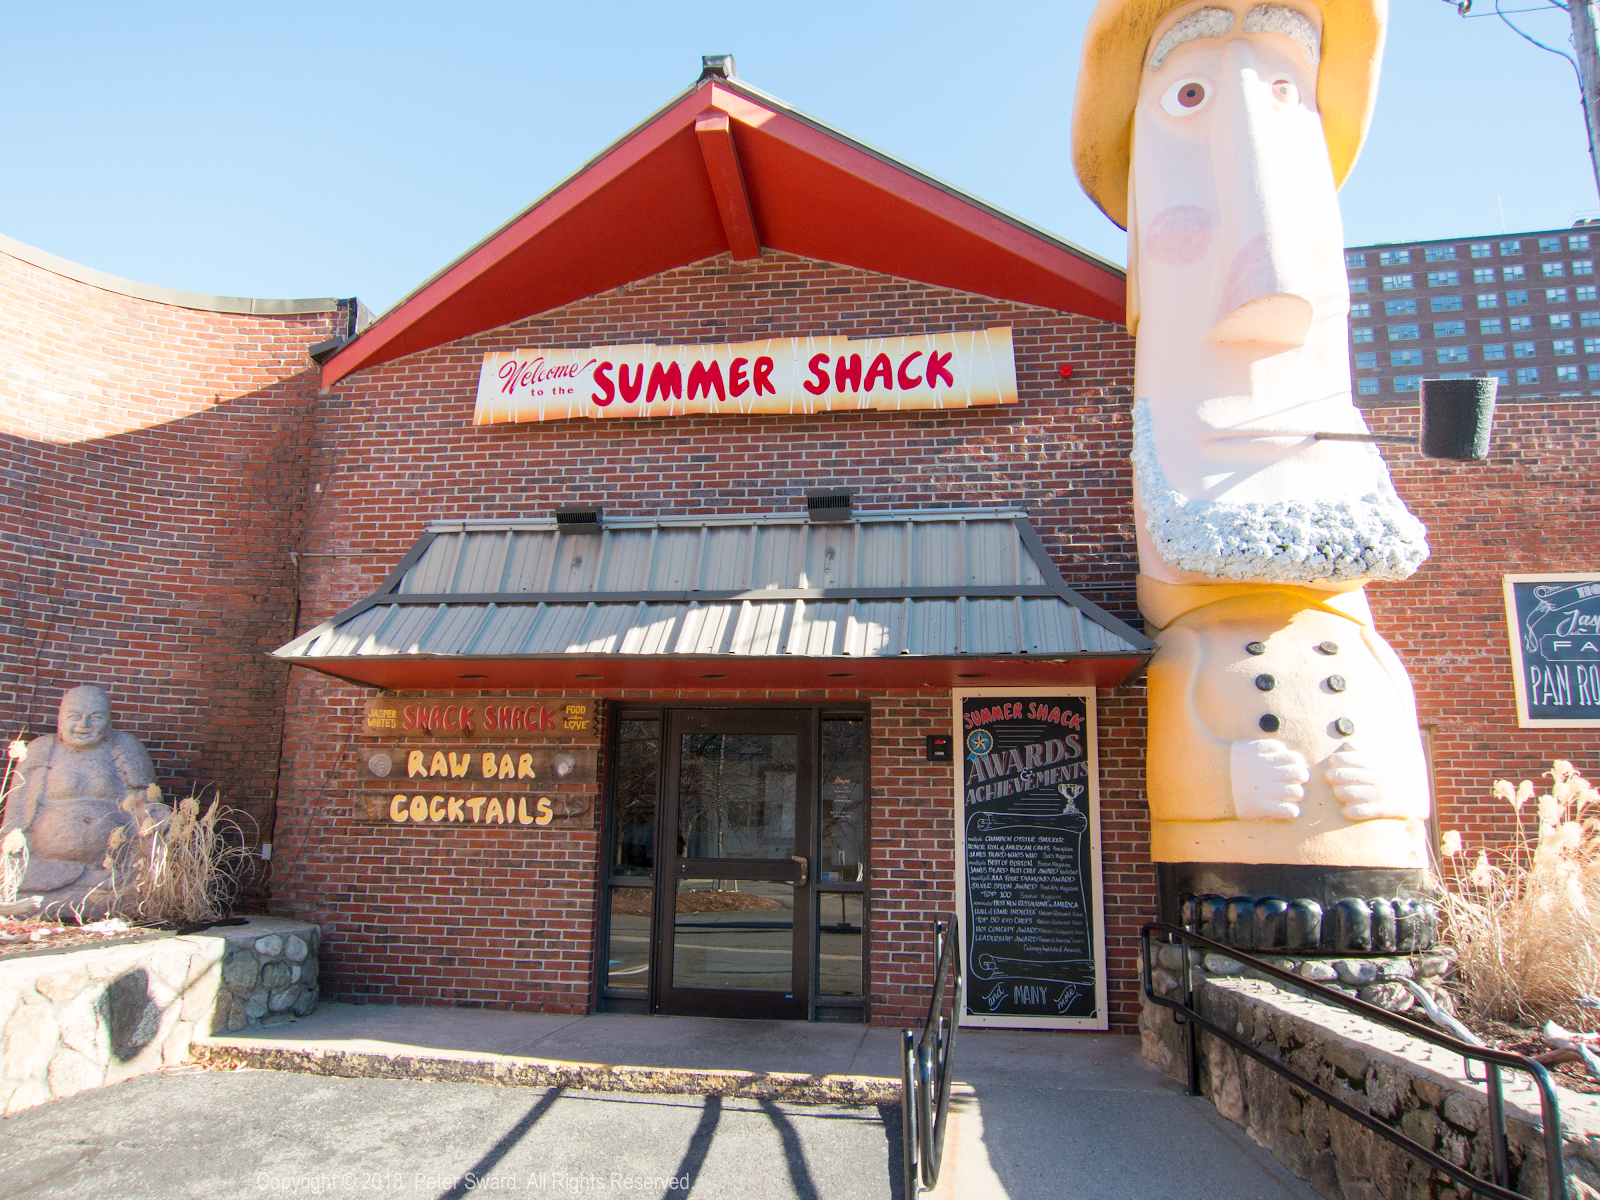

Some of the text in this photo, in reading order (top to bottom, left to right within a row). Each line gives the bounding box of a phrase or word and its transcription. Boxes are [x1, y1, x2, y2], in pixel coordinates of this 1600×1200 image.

[498, 356, 597, 395] Welcome
[591, 349, 954, 407] SUMMER SHACK
[531, 386, 574, 396] to the
[1530, 664, 1572, 706] PAN
[367, 708, 397, 719] JASPER
[402, 705, 556, 731] SNACK SHACK
[566, 705, 586, 714] FOOD
[963, 701, 1086, 732] SUMMER SHACK
[407, 750, 536, 780] RAW BAR
[966, 733, 1083, 786] AWARDS
[964, 760, 1089, 807] ACHIEVEMENTS
[1020, 767, 1034, 782] &
[389, 794, 554, 826] COCKTAILS
[985, 835, 1012, 843] CHAMPION
[999, 891, 1012, 899] 100
[975, 916, 989, 924] TOP
[990, 916, 1000, 924] 50
[1016, 926, 1040, 934] AWARD
[1014, 935, 1038, 943] AWARD
[988, 985, 1005, 1007] and
[1013, 985, 1048, 1005] MANY
